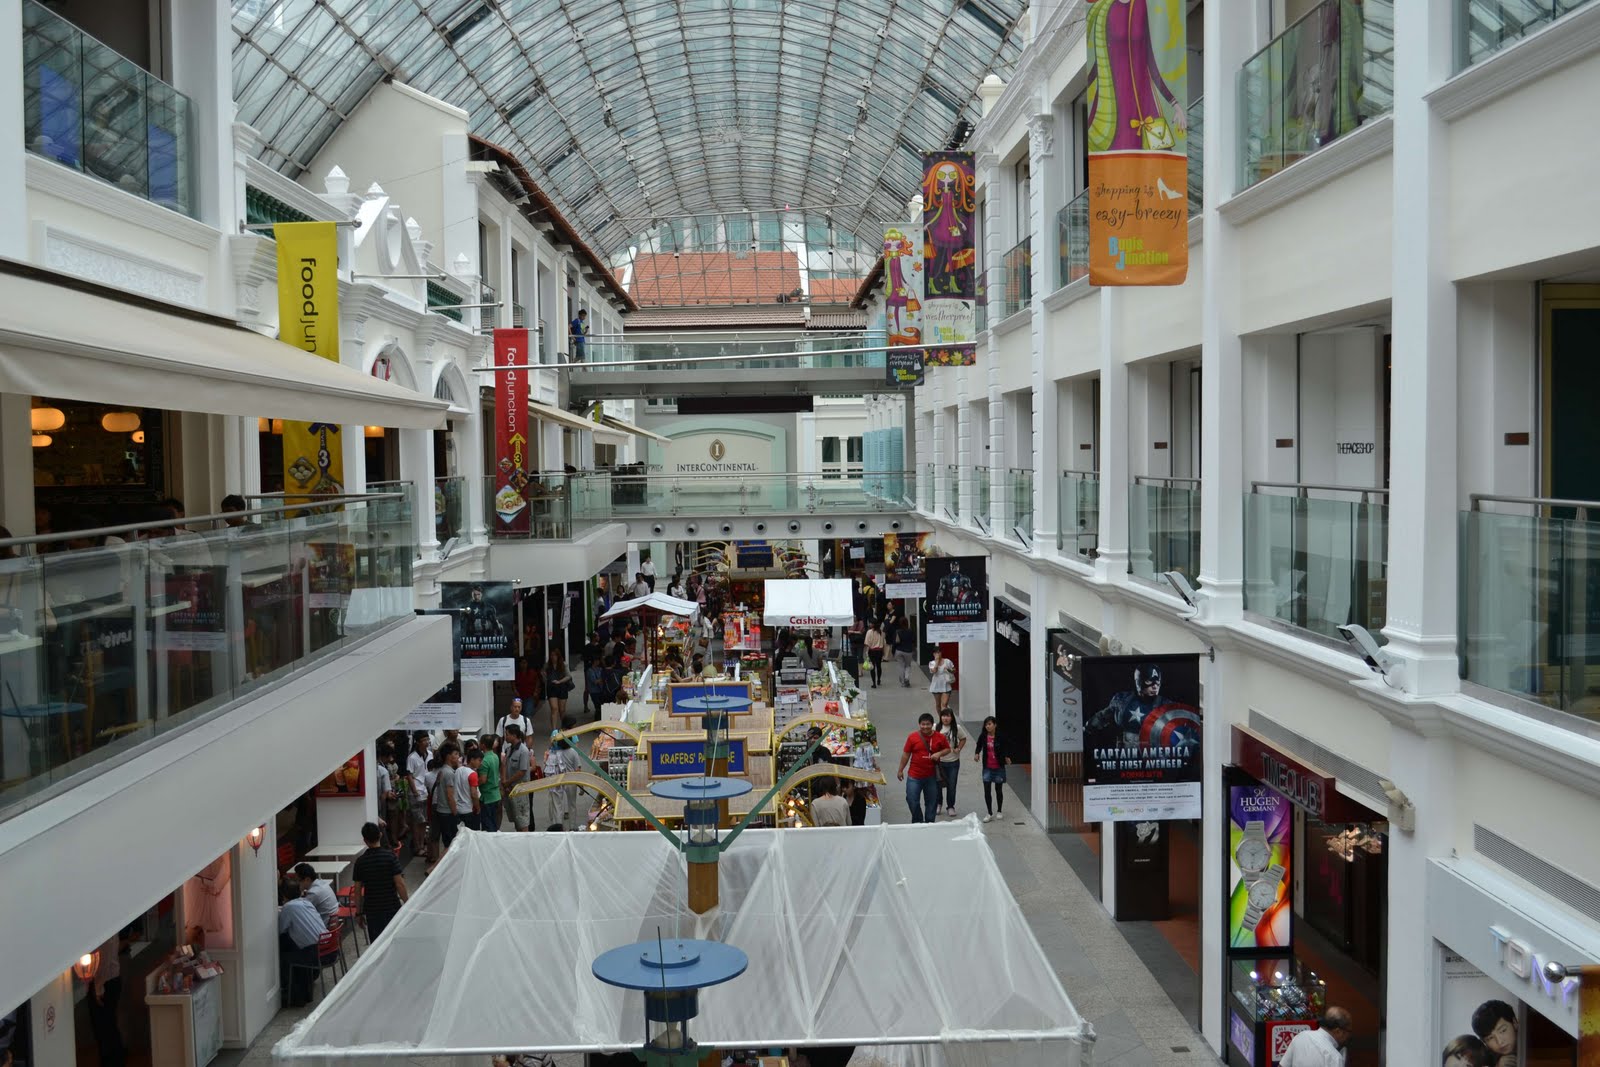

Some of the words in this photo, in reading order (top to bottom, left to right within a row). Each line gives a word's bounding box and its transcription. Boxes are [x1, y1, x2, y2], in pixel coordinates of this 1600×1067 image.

[1096, 200, 1182, 230] easy-breezy
[1108, 236, 1144, 256] Bugis
[1116, 250, 1169, 270] Junction
[300, 258, 319, 353] foodjun
[319, 450, 328, 467] 3
[514, 454, 522, 464] 3
[790, 616, 827, 624] Cashier
[660, 752, 696, 765] KRAFERS'
[1094, 748, 1138, 760] CAPTAIN
[1142, 746, 1190, 758] AMERICA
[1102, 760, 1117, 770] THE
[1120, 760, 1142, 770] FIRST
[1145, 759, 1182, 769] AVENGER
[1240, 796, 1280, 807] HUGEN
[1488, 925, 1578, 1009] TONY
